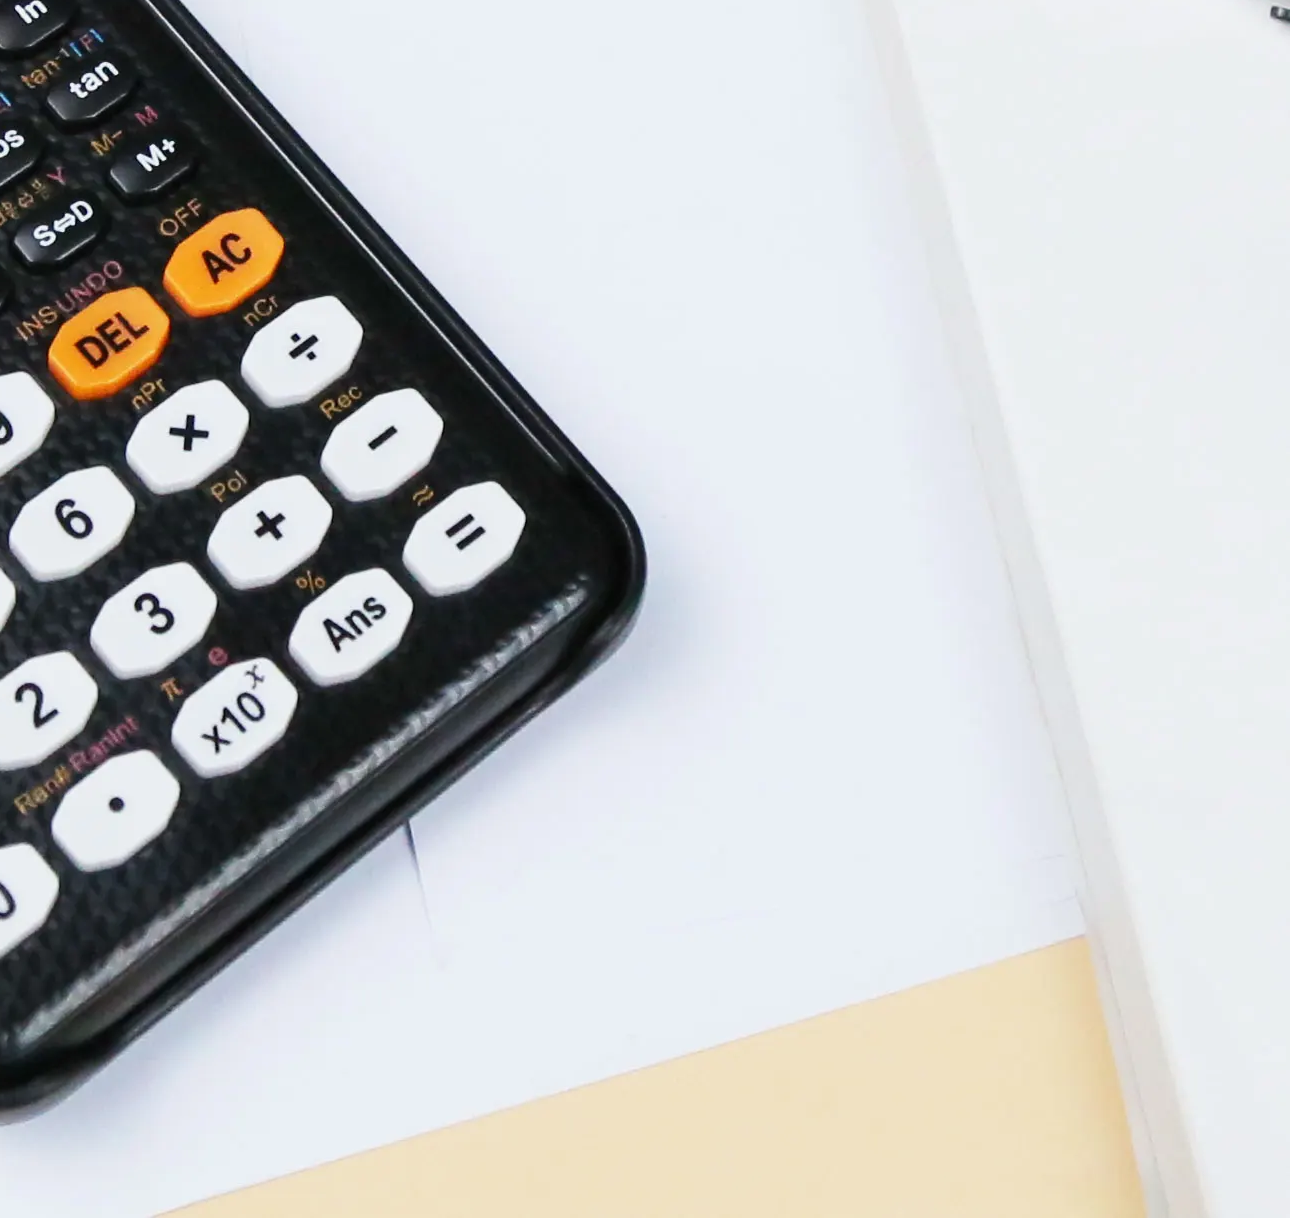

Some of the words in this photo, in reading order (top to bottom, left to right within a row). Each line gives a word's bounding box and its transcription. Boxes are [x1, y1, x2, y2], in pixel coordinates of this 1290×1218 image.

[69, 61, 120, 99] tan
[134, 104, 159, 128] M
[136, 138, 176, 172] M+
[160, 197, 203, 237] OFF
[201, 233, 252, 284] AC
[16, 305, 58, 342] INS
[56, 260, 123, 313] UNDO
[242, 293, 279, 327] nCr
[74, 312, 150, 369] DEL
[131, 377, 167, 410] nPr
[320, 384, 364, 420] Rec
[54, 498, 94, 539] 6
[134, 593, 175, 635] 3
[322, 597, 387, 653] Ans
[15, 682, 59, 729] 2
